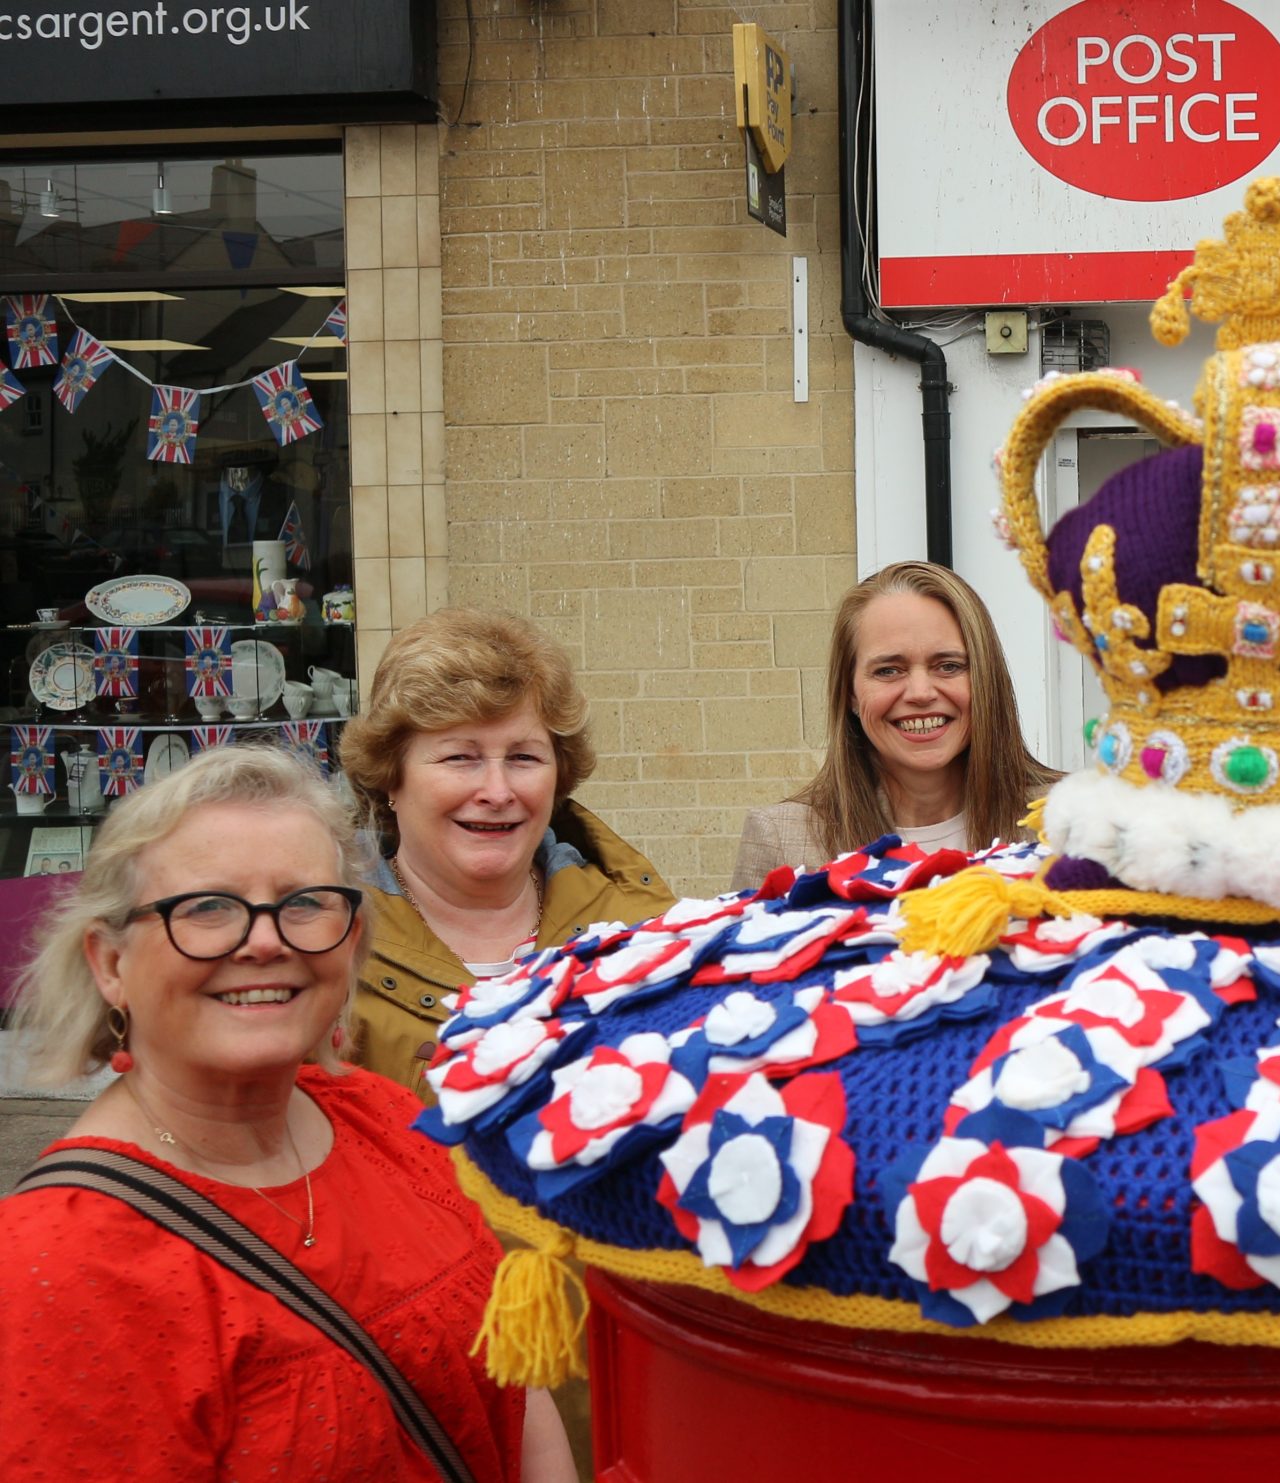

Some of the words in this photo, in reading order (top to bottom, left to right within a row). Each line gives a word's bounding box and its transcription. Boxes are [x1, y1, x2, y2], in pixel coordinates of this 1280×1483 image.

[1076, 33, 1236, 85] POST
[766, 89, 780, 120] Pay
[1036, 92, 1260, 146] OFFICE
[767, 117, 785, 149] Point
